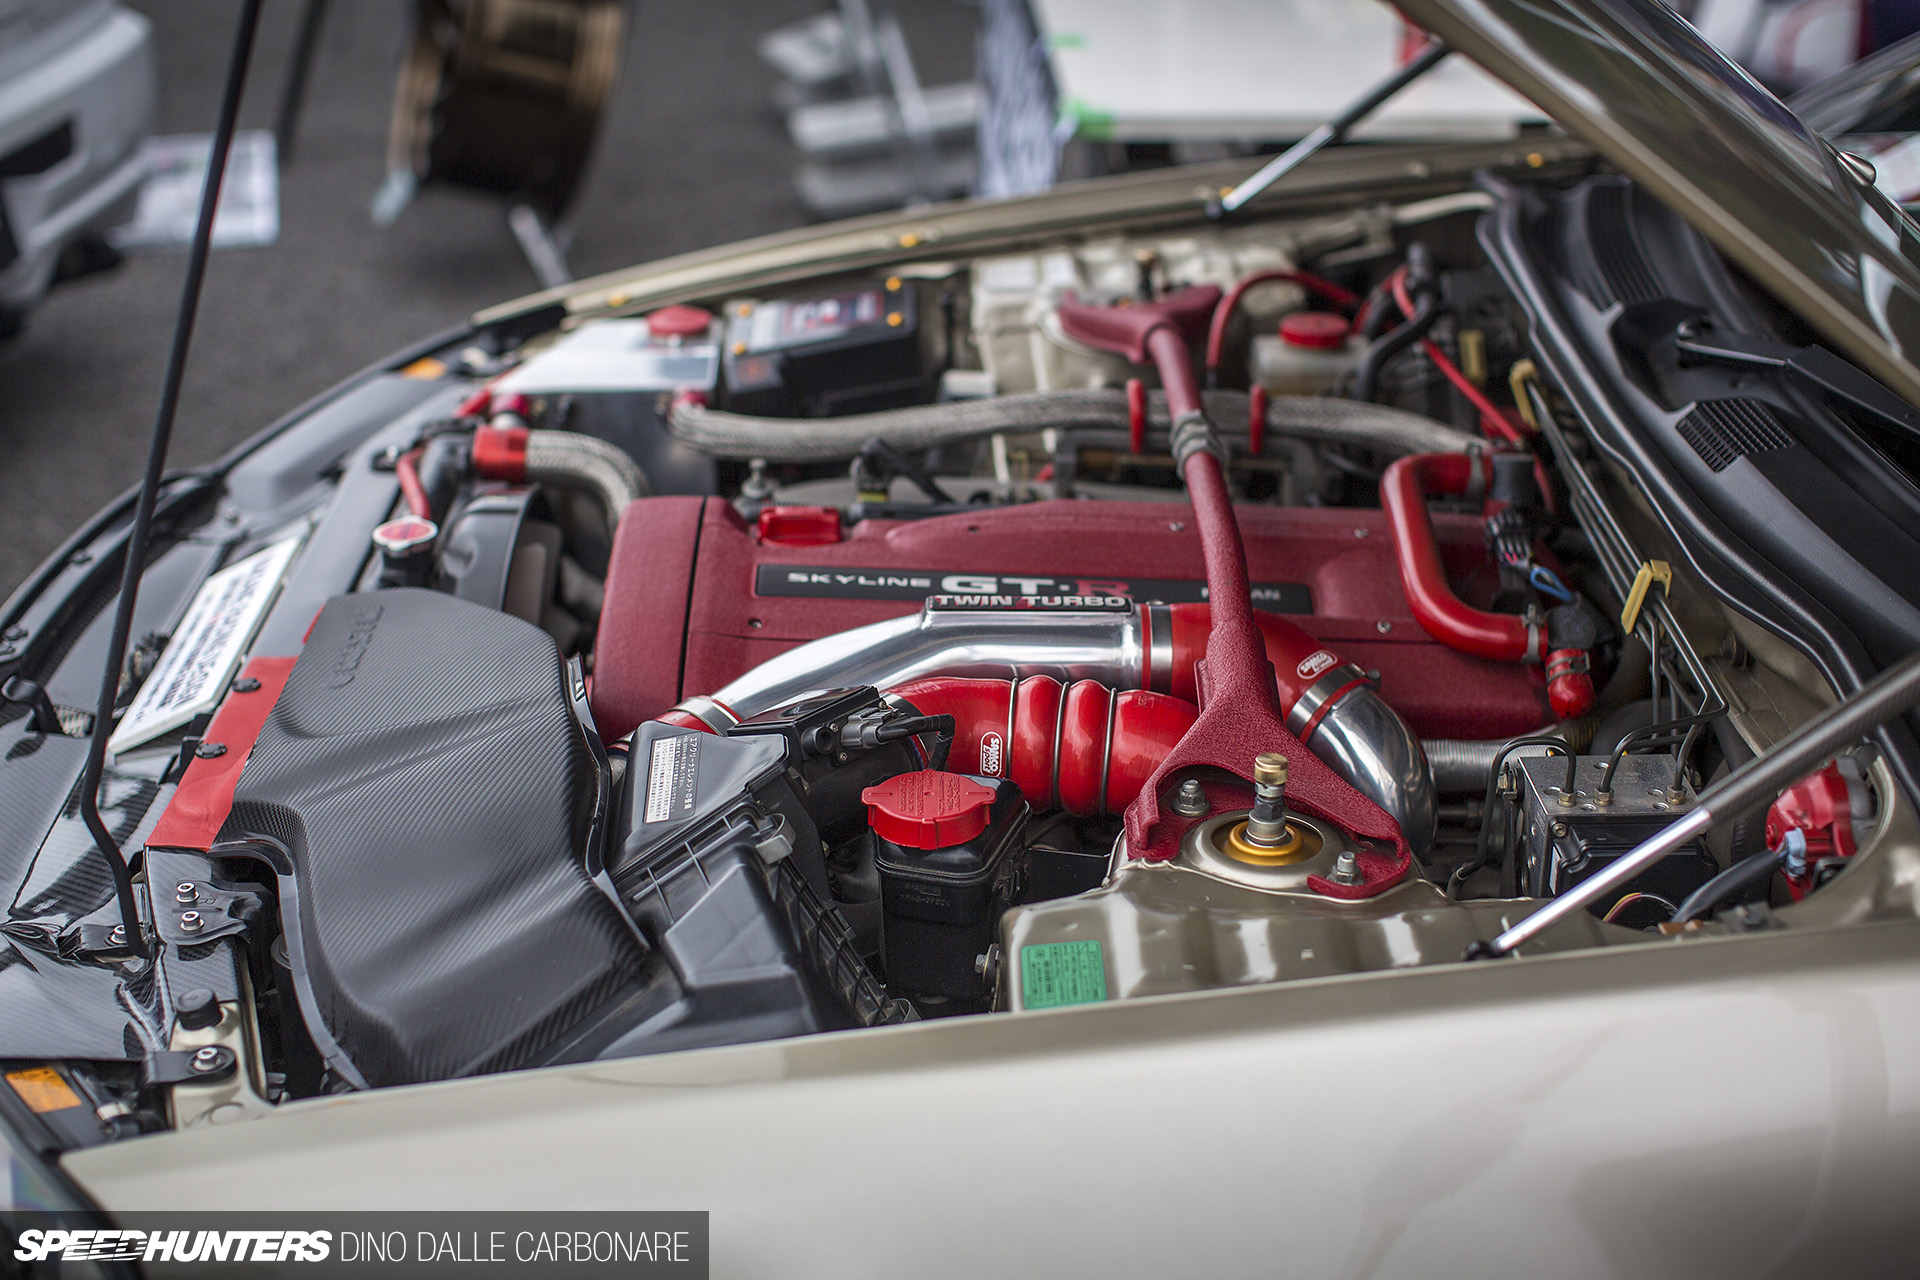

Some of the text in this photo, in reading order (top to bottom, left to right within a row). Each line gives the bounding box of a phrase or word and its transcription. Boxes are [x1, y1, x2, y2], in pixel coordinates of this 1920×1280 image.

[787, 572, 931, 588] SKYLINE
[933, 595, 1127, 607] TWIN TURBO
[990, 737, 1000, 773] SAMCO
